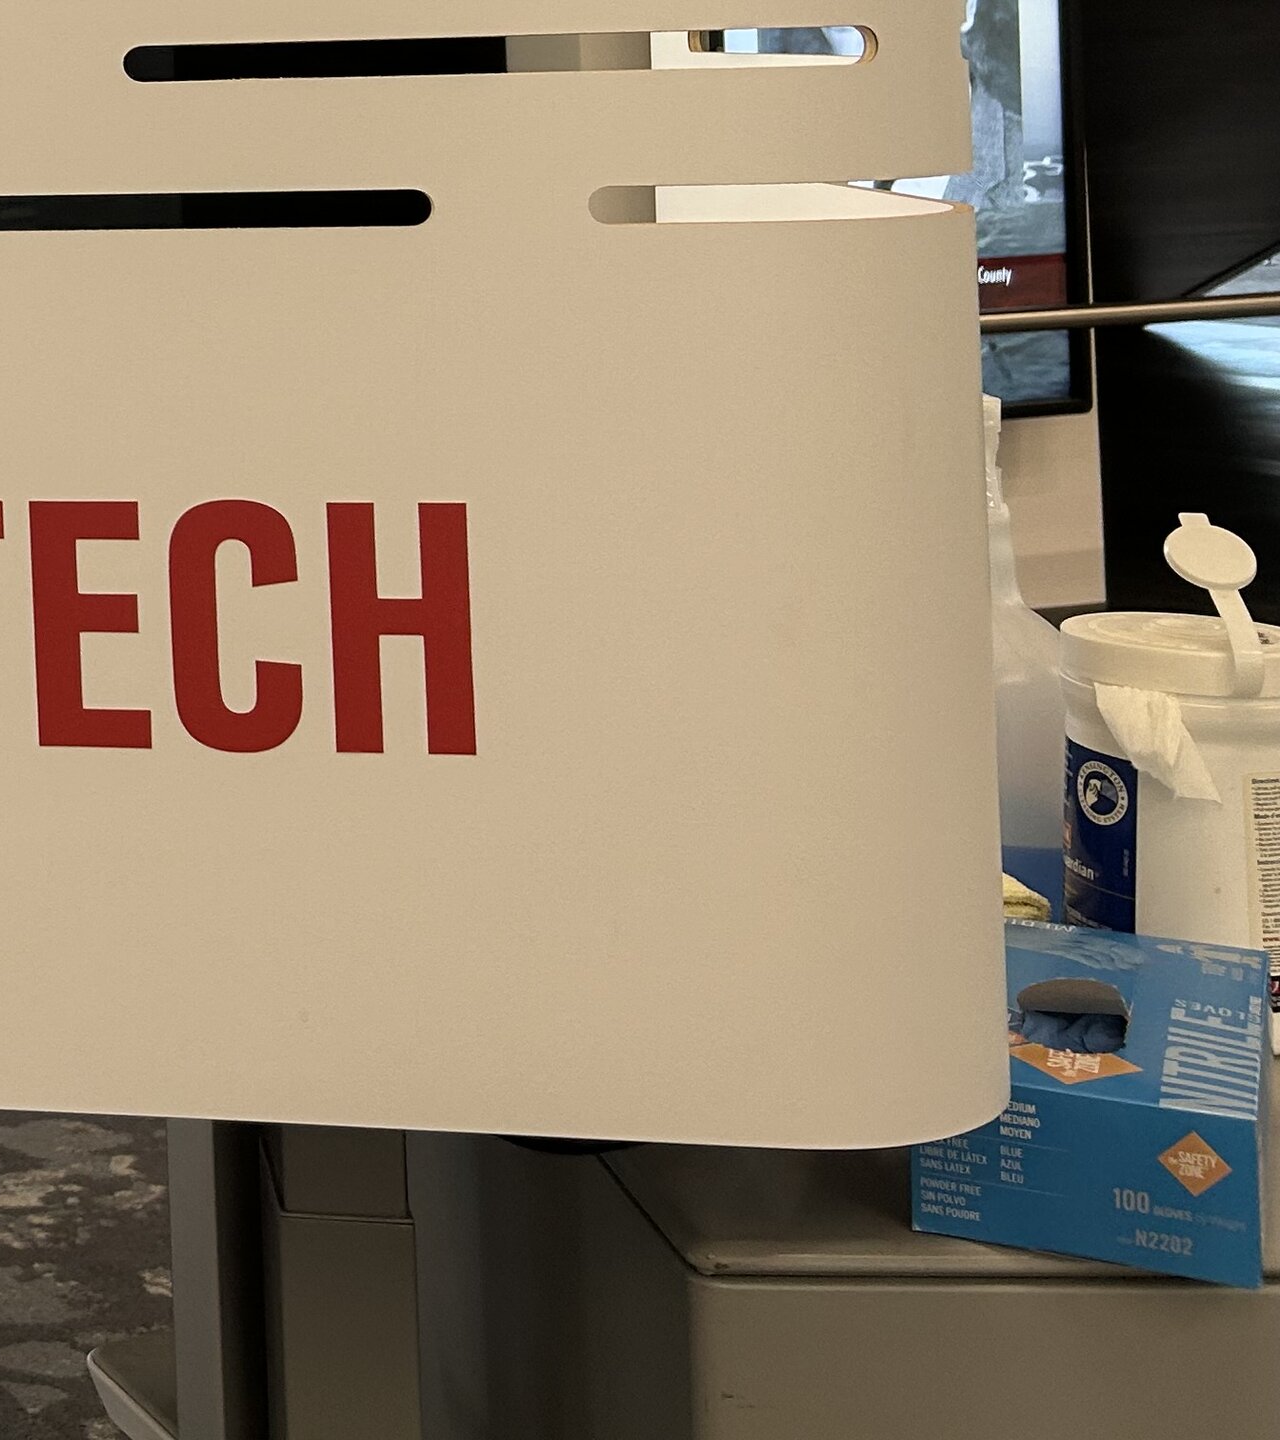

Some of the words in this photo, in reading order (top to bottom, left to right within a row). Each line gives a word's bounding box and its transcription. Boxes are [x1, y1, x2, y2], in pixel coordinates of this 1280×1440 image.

[977, 265, 1012, 287] County
[1159, 1007, 1262, 1121] NITRILE
[1007, 1101, 1036, 1114] EDIUM
[1000, 1126, 1032, 1139] MOYEN
[1000, 1146, 1023, 1157] BLUE
[1178, 1151, 1217, 1168] SAFETY
[1113, 1187, 1149, 1214] 100
[1135, 1228, 1193, 1255] N2202
